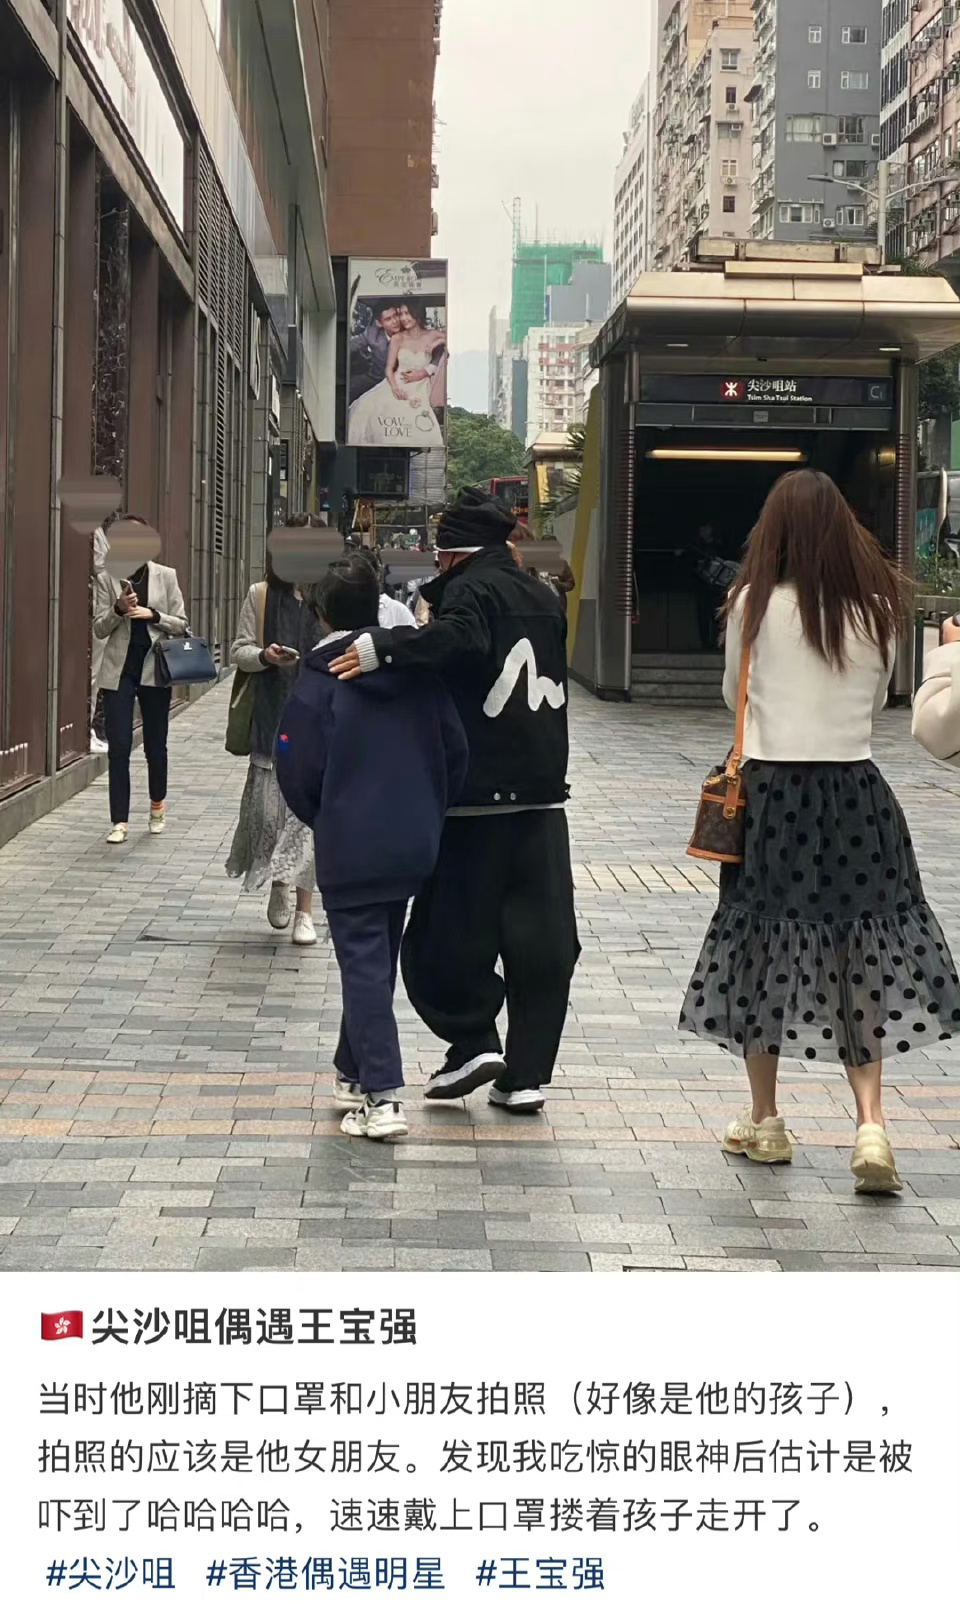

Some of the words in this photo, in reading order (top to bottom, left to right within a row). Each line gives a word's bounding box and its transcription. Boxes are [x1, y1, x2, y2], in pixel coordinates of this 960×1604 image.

[747, 379, 797, 392] 尖沙咀站
[384, 427, 412, 438] LOVE
